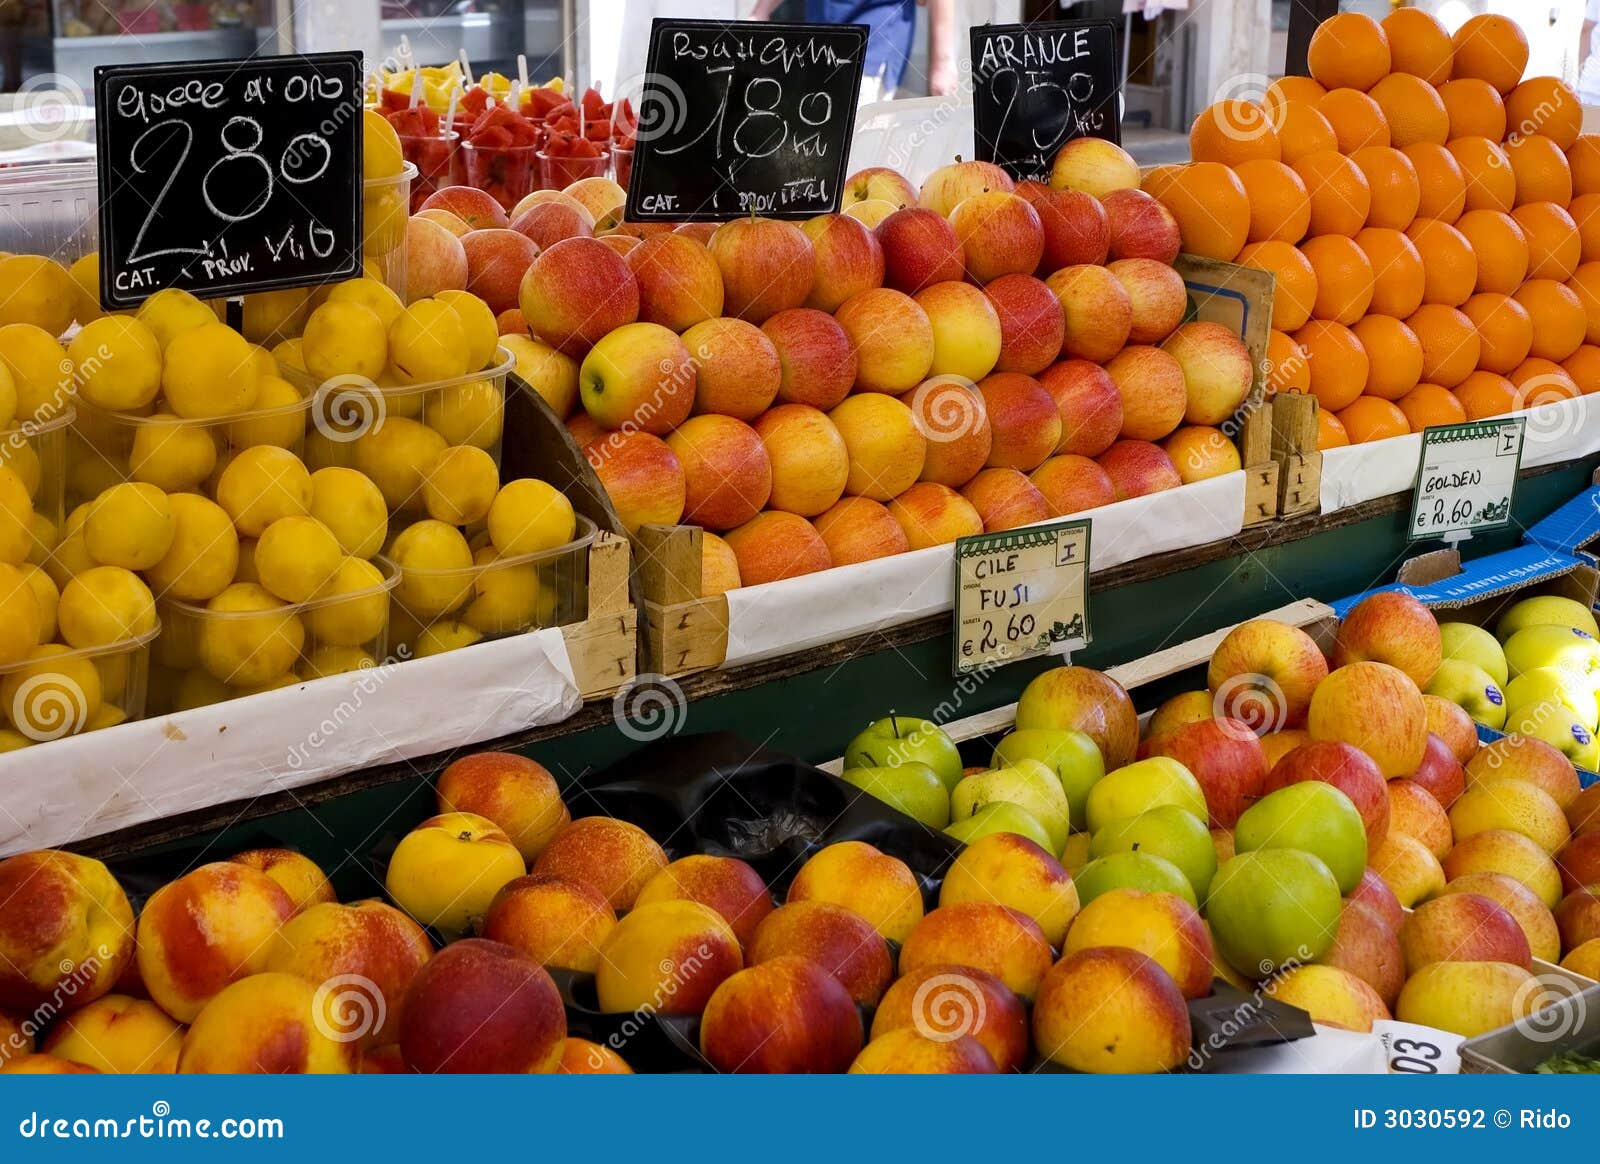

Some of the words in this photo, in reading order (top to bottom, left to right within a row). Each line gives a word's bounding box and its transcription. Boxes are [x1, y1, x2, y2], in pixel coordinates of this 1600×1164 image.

[980, 28, 1090, 68] ARANCE
[642, 194, 680, 212] CAT.
[115, 267, 161, 291] CAT.
[202, 253, 255, 280] PROV.
[1425, 469, 1481, 493] GOLDEN
[1432, 498, 1472, 526] 2,60
[975, 554, 1019, 580] CILE
[980, 583, 1029, 611] FUJI
